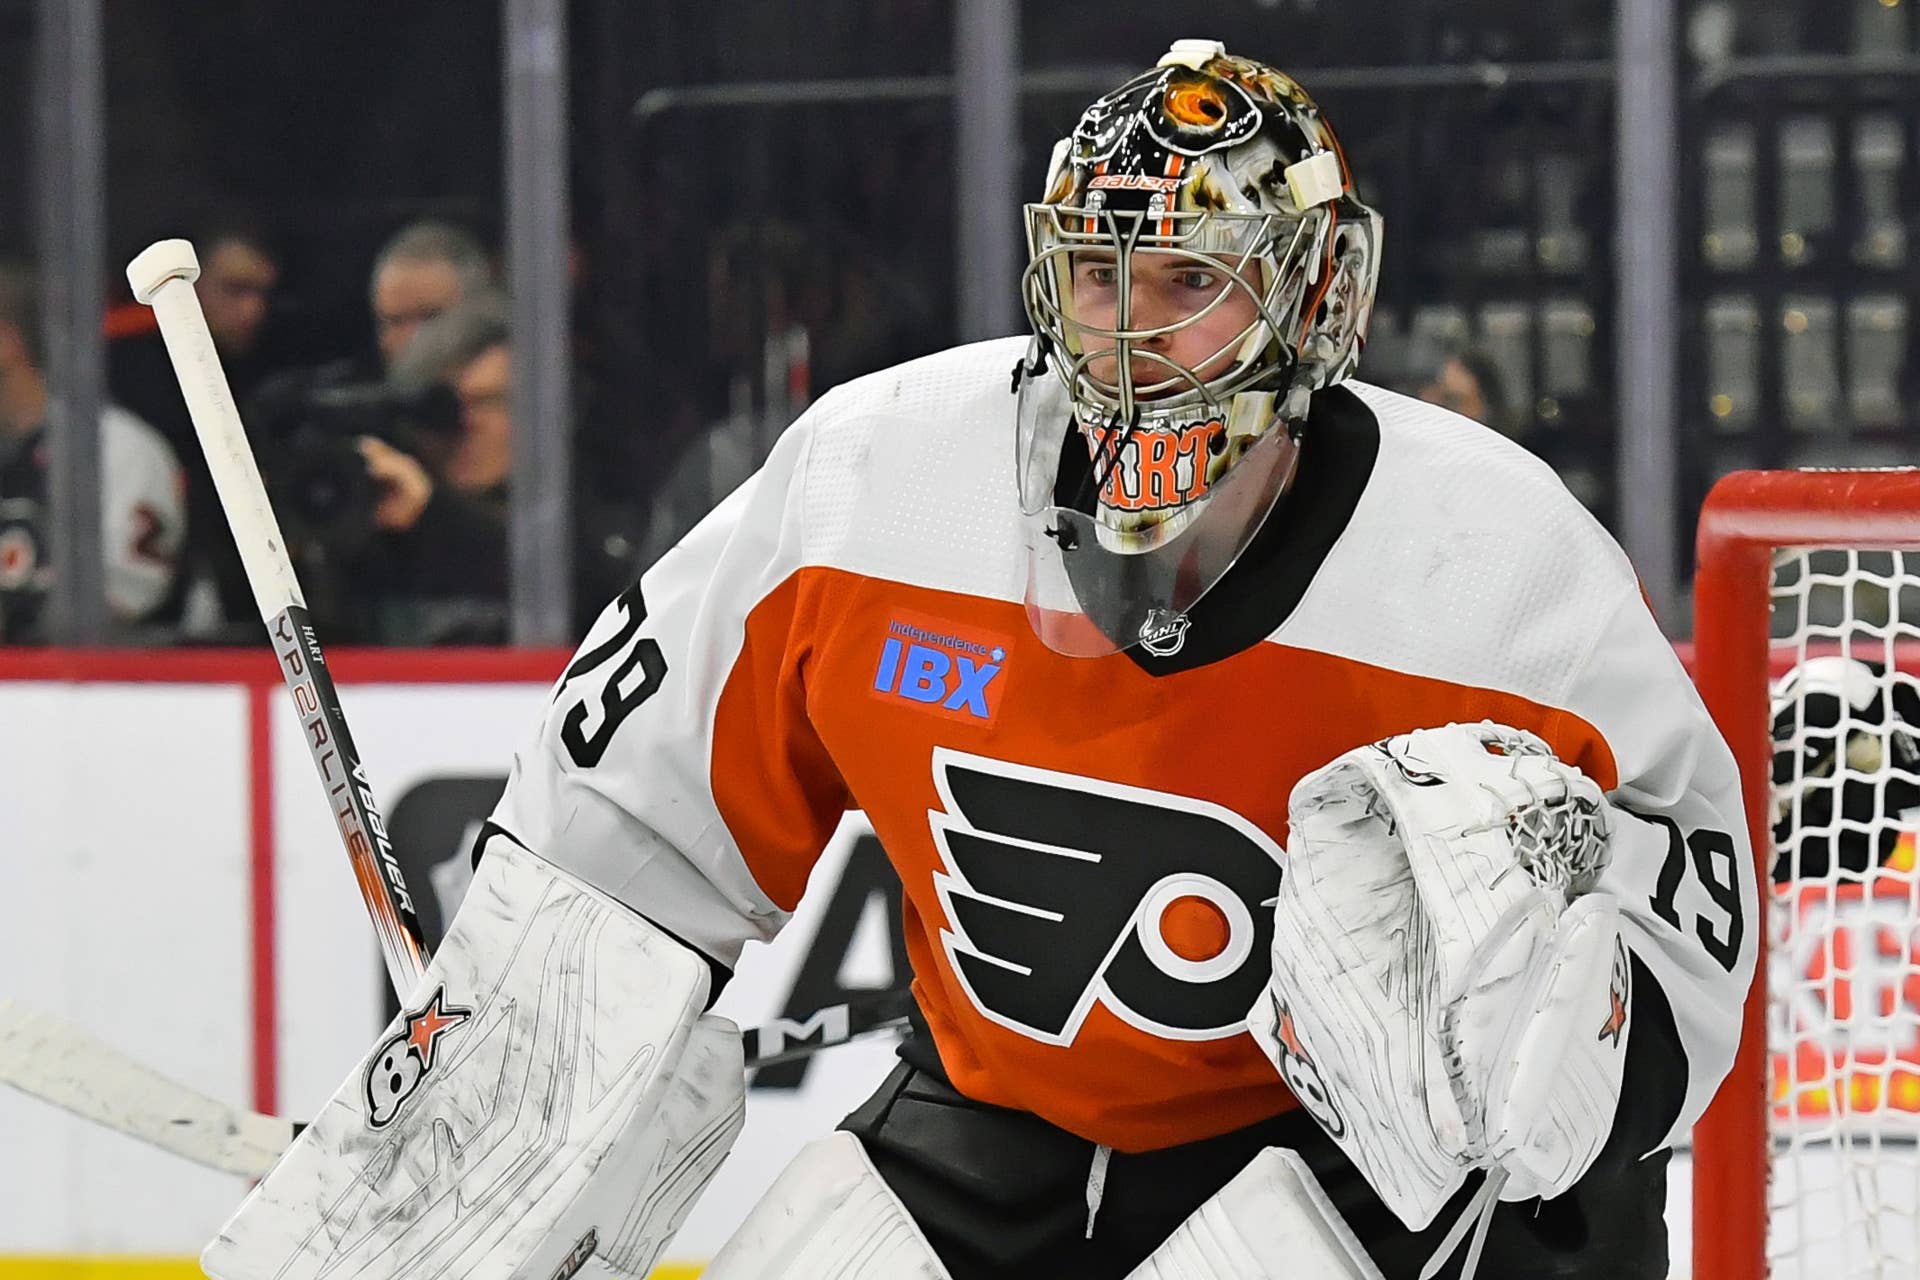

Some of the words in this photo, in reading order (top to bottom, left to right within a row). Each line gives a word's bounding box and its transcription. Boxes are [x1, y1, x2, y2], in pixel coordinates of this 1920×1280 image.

[1087, 174, 1181, 192] BAUER
[301, 625, 325, 665] HART
[889, 619, 987, 655] Independence
[874, 637, 1001, 718] IBX
[357, 784, 417, 915] BAUER
[1613, 801, 1744, 973] 79
